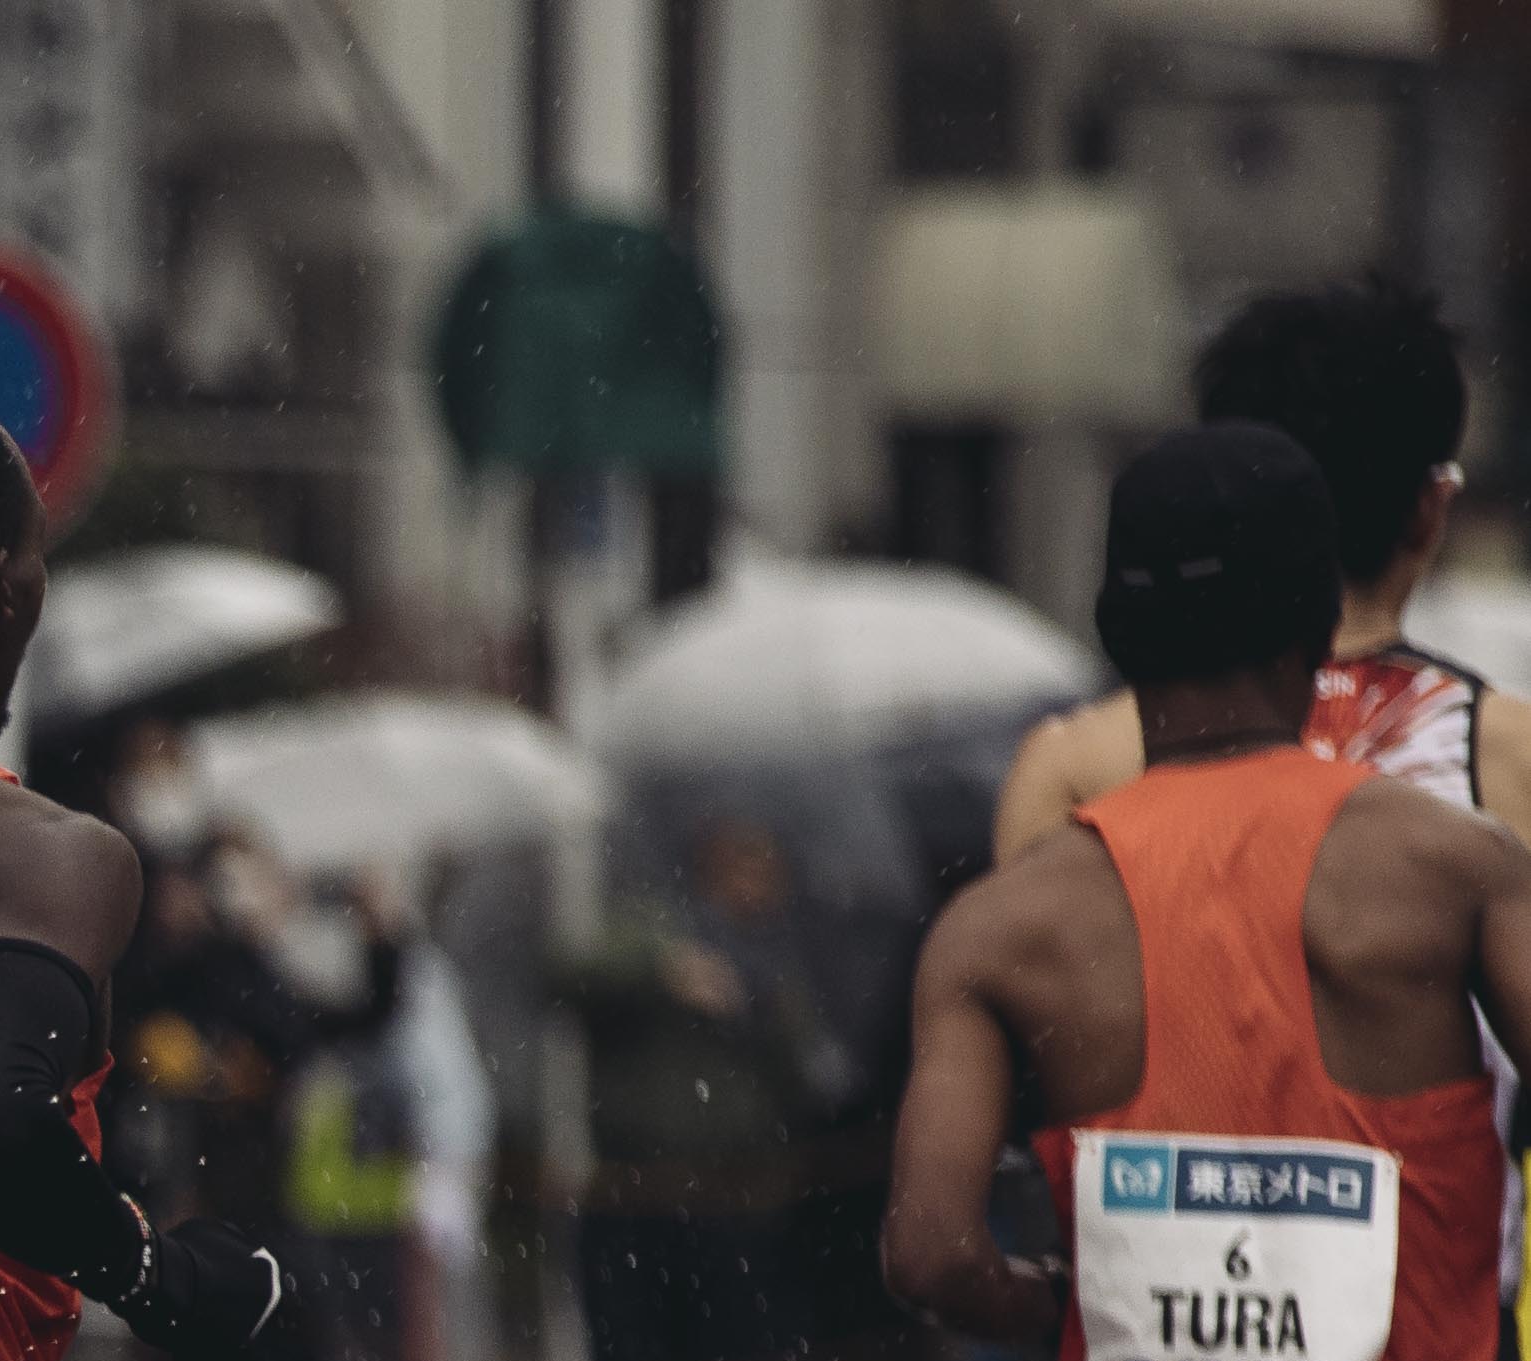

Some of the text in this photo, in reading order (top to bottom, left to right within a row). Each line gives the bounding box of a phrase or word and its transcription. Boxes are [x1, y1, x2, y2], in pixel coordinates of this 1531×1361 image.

[1188, 1159, 1363, 1210] 東京メトロ
[1225, 1228, 1252, 1280] 6
[1150, 1286, 1306, 1353] TURA
